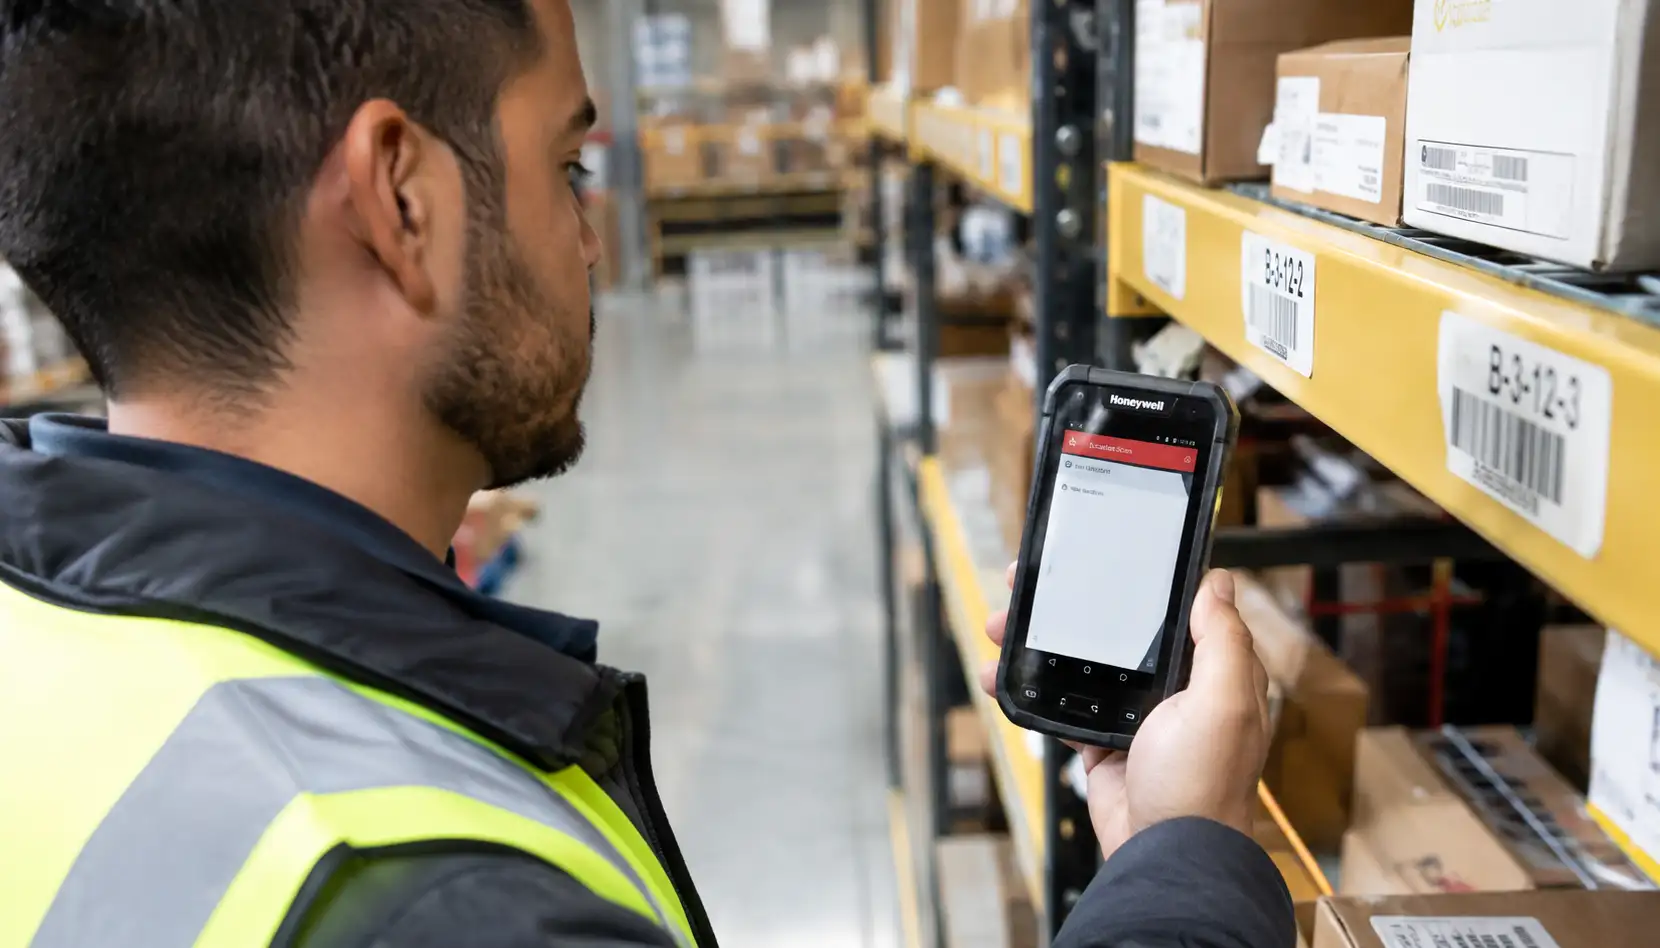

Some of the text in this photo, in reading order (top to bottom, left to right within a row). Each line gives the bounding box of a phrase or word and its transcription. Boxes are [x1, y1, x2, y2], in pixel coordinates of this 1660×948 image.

[1264, 248, 1304, 298] B-3-12-2
[1109, 394, 1165, 412] Honeywell
[1488, 344, 1582, 429] B-3-12-3
